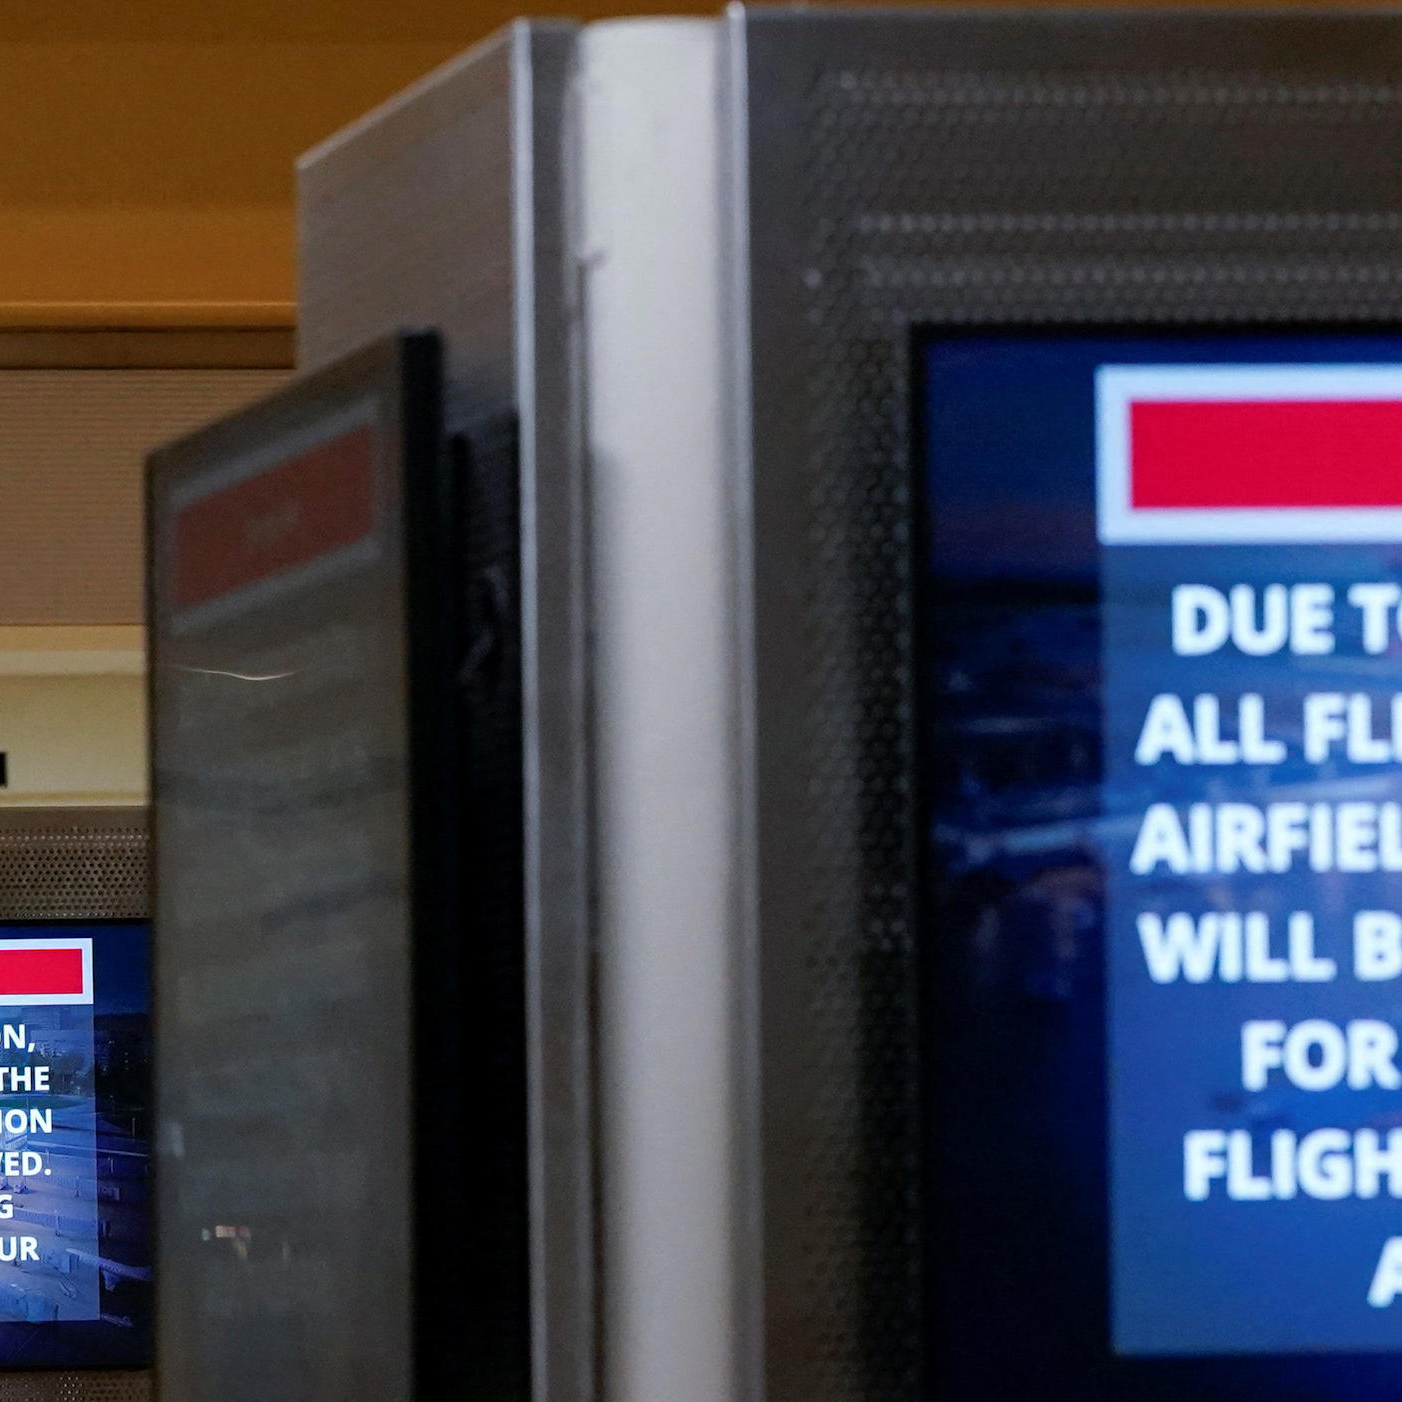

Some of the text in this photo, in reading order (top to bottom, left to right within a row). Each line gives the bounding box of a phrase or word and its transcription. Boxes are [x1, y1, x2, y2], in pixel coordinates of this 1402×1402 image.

[1175, 586, 1332, 653] DUE
[1139, 696, 1283, 762] ALL
[1141, 914, 1333, 980] WILL
[1244, 1021, 1398, 1088] FOR
